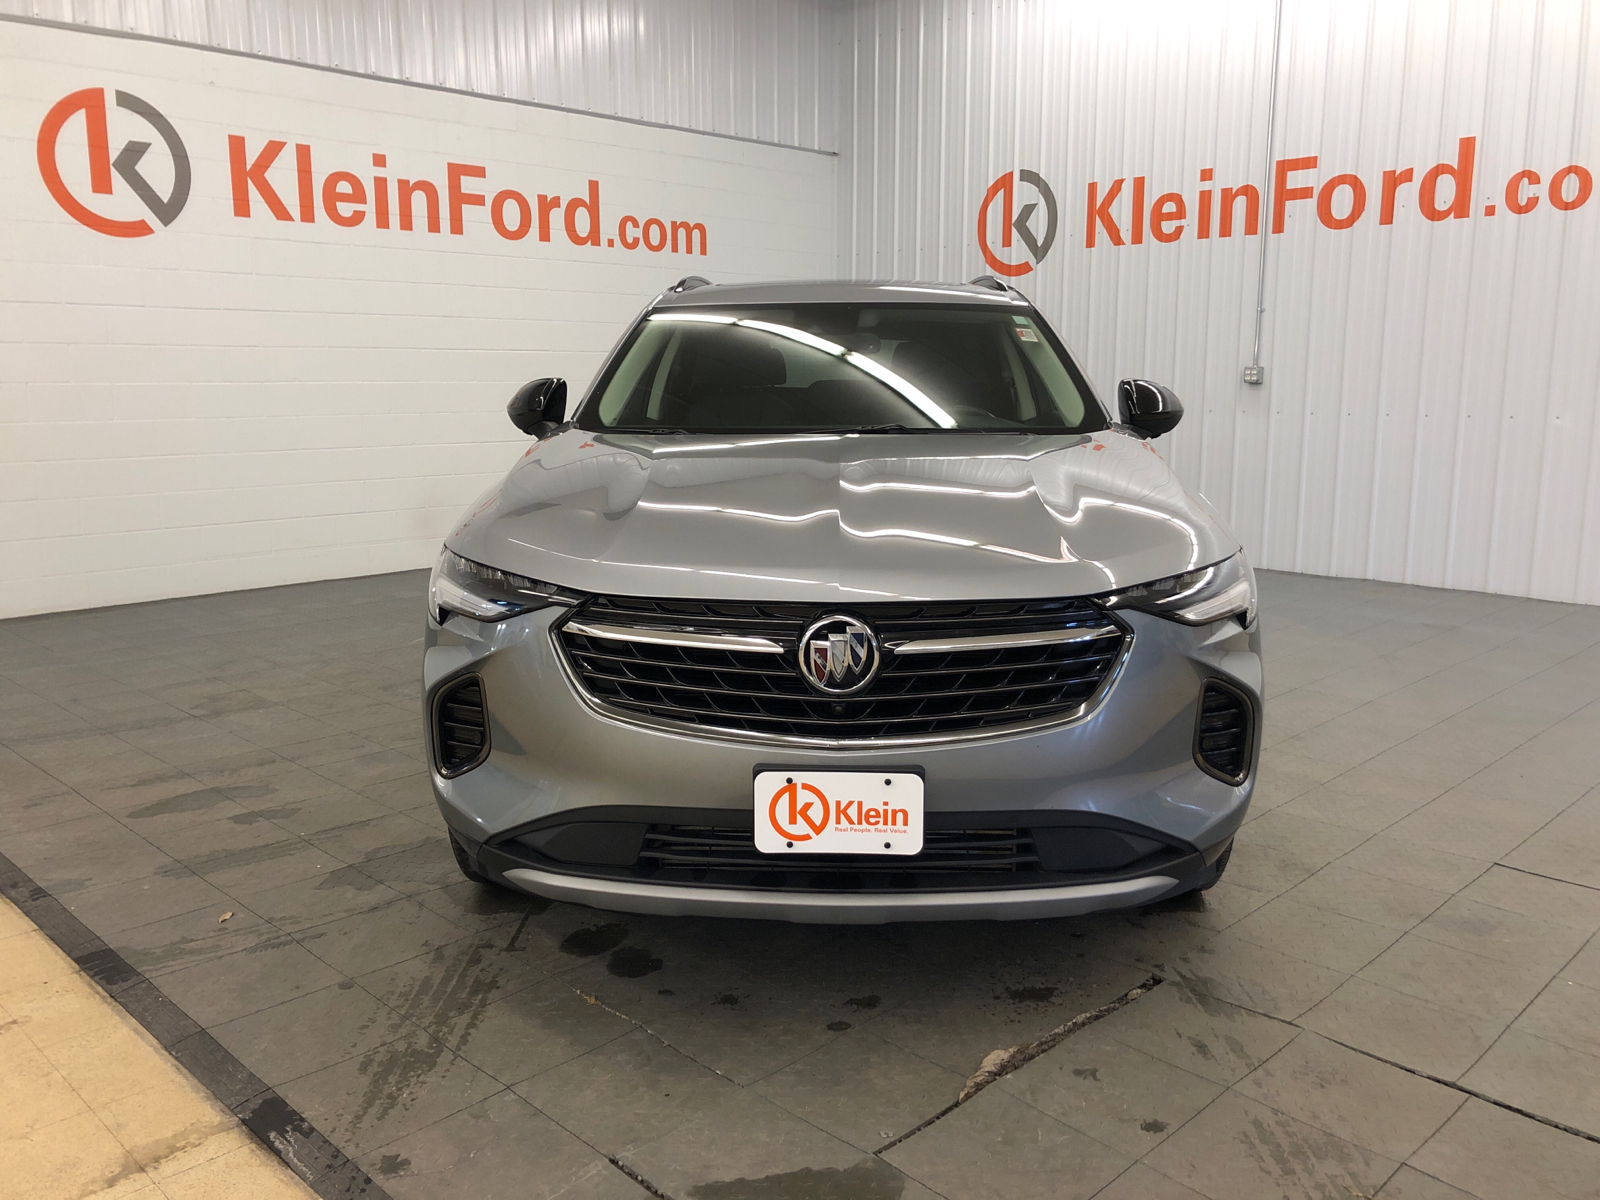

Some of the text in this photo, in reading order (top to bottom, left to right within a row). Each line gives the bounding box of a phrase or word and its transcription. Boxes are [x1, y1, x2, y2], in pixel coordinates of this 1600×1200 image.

[227, 133, 708, 257] KleinFord.com
[1085, 135, 1594, 249] KleinFord.co
[834, 800, 909, 827] Klein
[849, 826, 873, 834] People.
